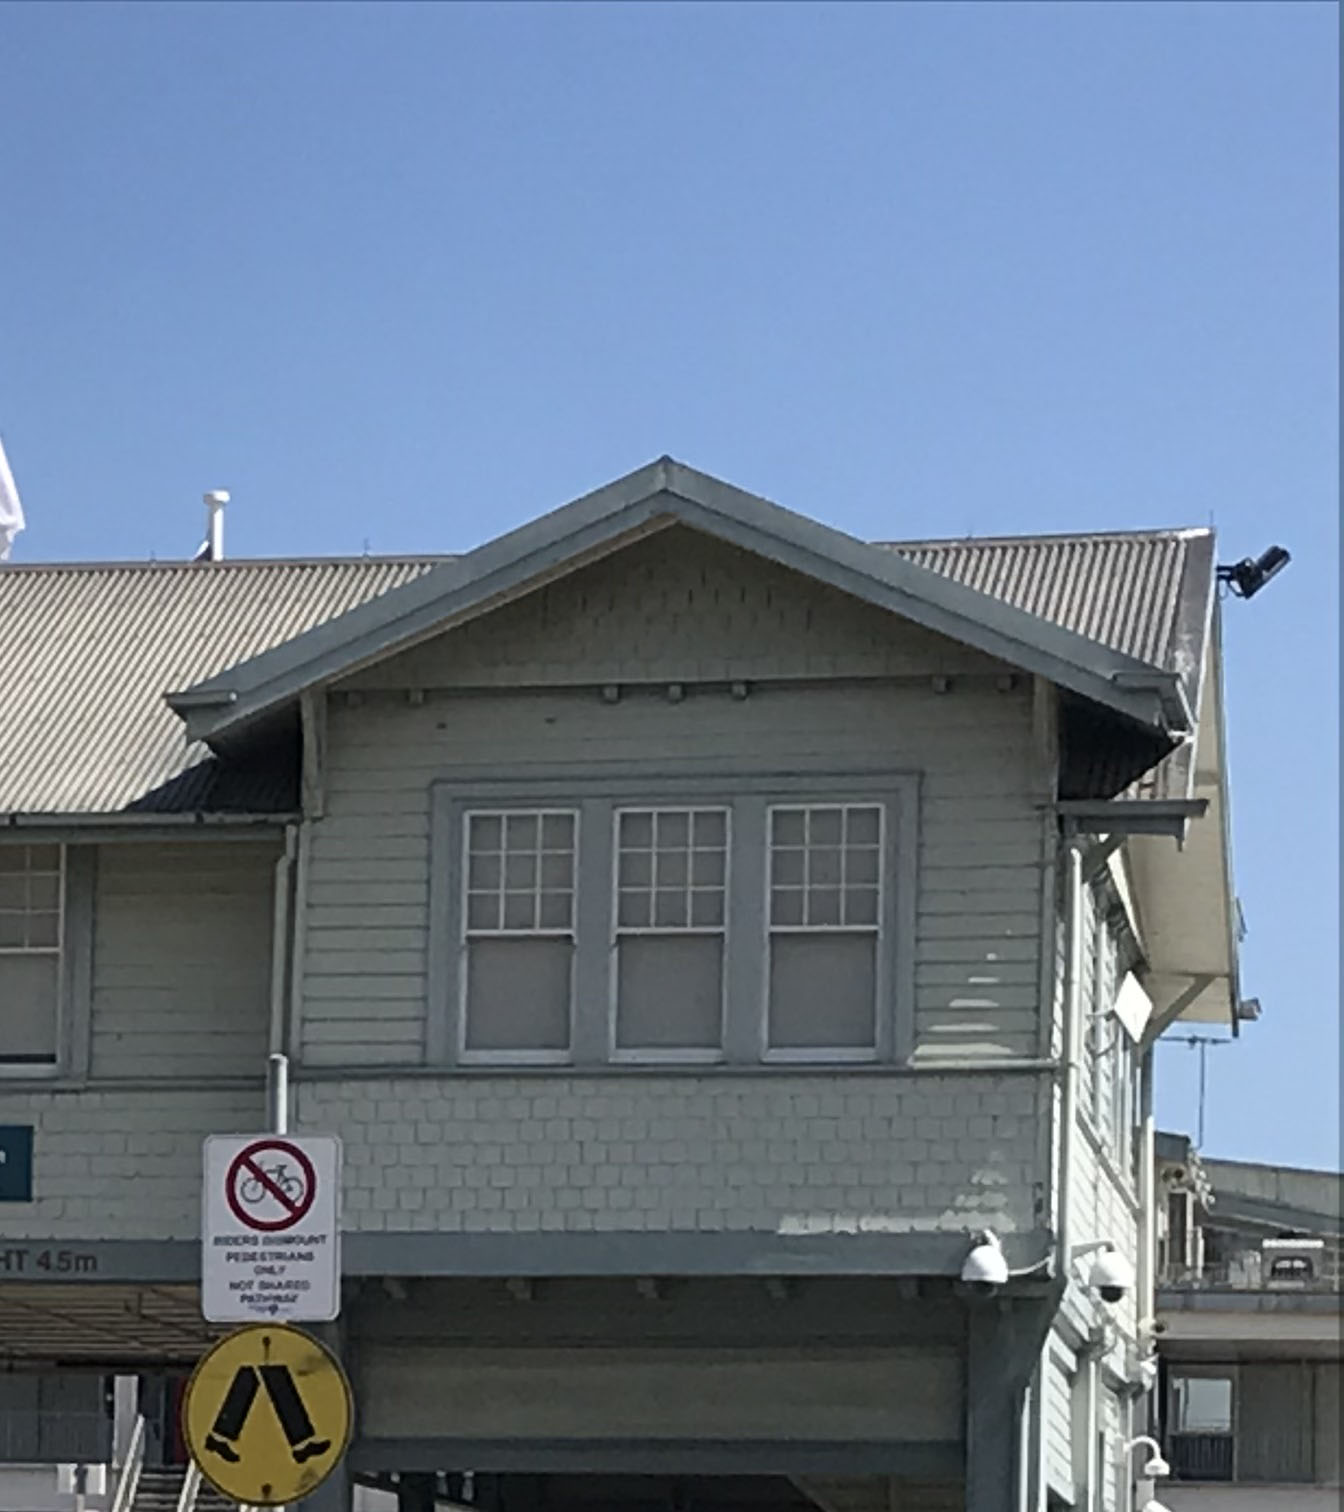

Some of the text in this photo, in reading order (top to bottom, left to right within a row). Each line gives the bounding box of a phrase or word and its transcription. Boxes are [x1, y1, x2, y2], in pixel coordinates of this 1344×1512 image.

[226, 1251, 314, 1262] PEDESTRIANS
[253, 1265, 286, 1275] ONLY
[229, 1281, 254, 1291] NOT
